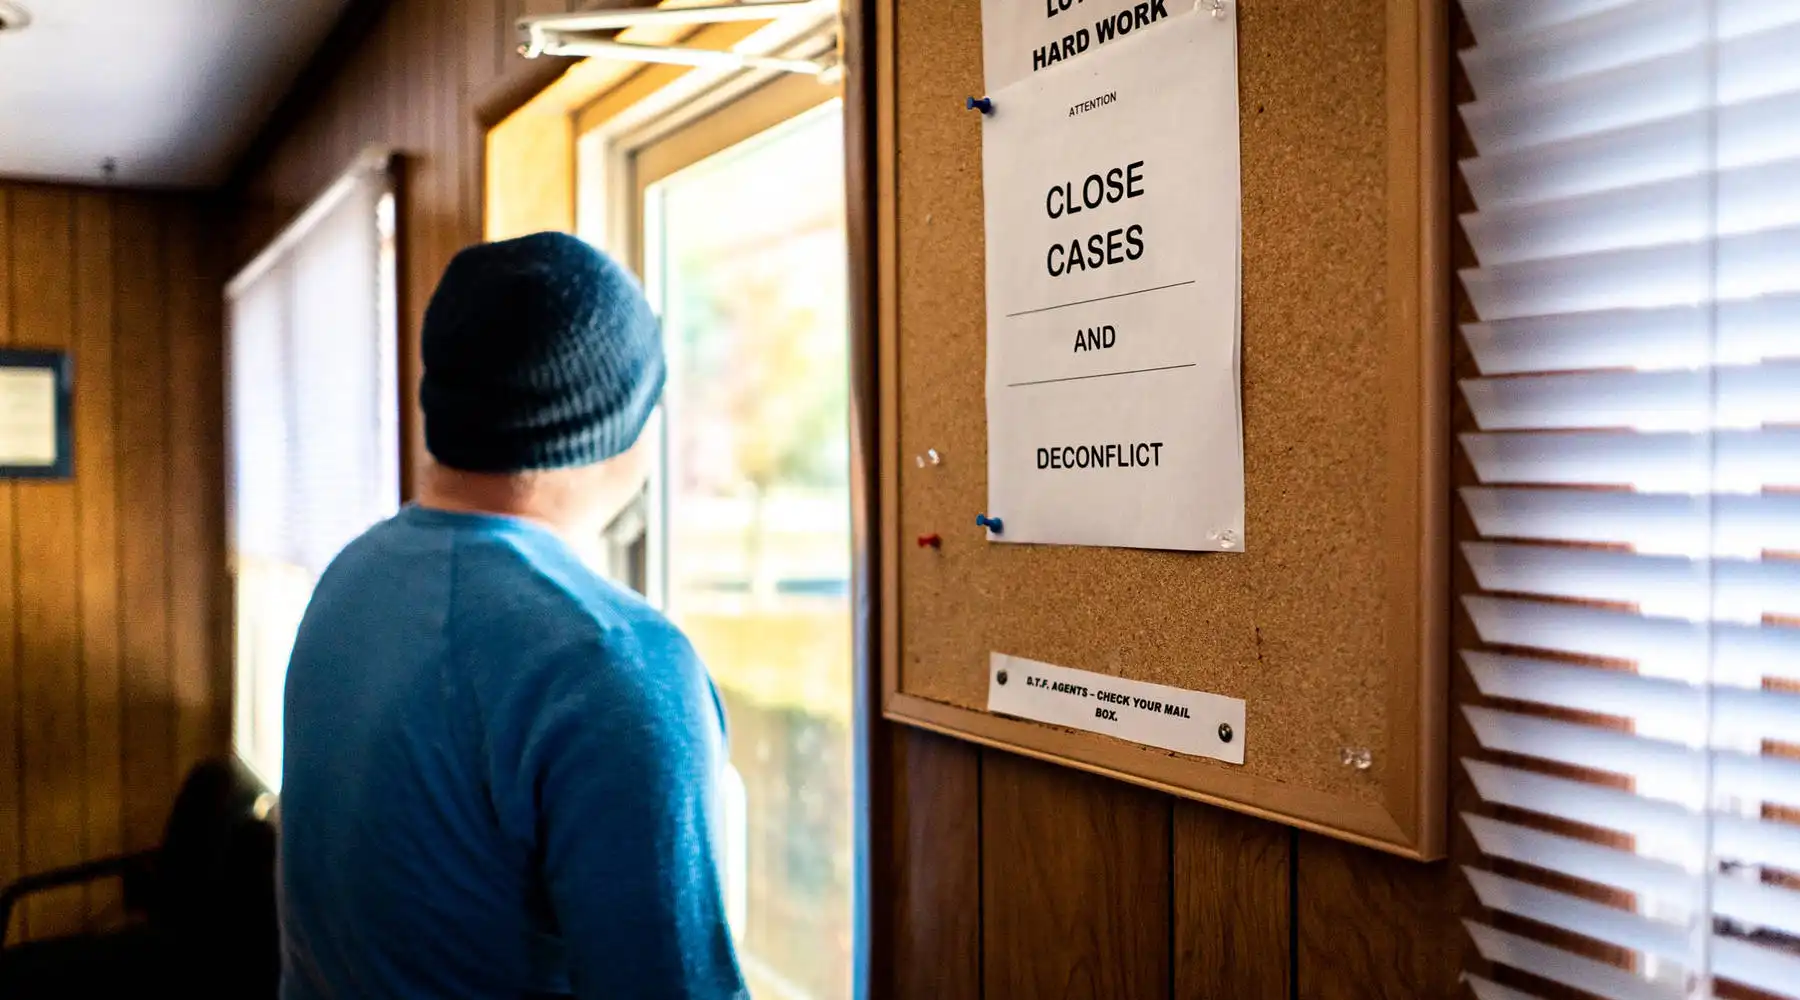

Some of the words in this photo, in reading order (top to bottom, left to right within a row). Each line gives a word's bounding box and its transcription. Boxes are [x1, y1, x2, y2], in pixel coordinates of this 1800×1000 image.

[1032, 28, 1090, 72] HARD
[1095, 0, 1169, 45] WORK
[1068, 91, 1118, 118] ATTENTION
[1046, 160, 1145, 220] CLOSE
[1046, 223, 1145, 278] CASES
[1073, 325, 1117, 353] AND
[1036, 442, 1164, 470] DECONFLICT
[1051, 681, 1089, 698] AGENTS
[1096, 690, 1131, 707] CHECK
[1132, 697, 1162, 713] YOUR
[1163, 703, 1191, 720] MAIL
[1094, 707, 1119, 722] BOX.
